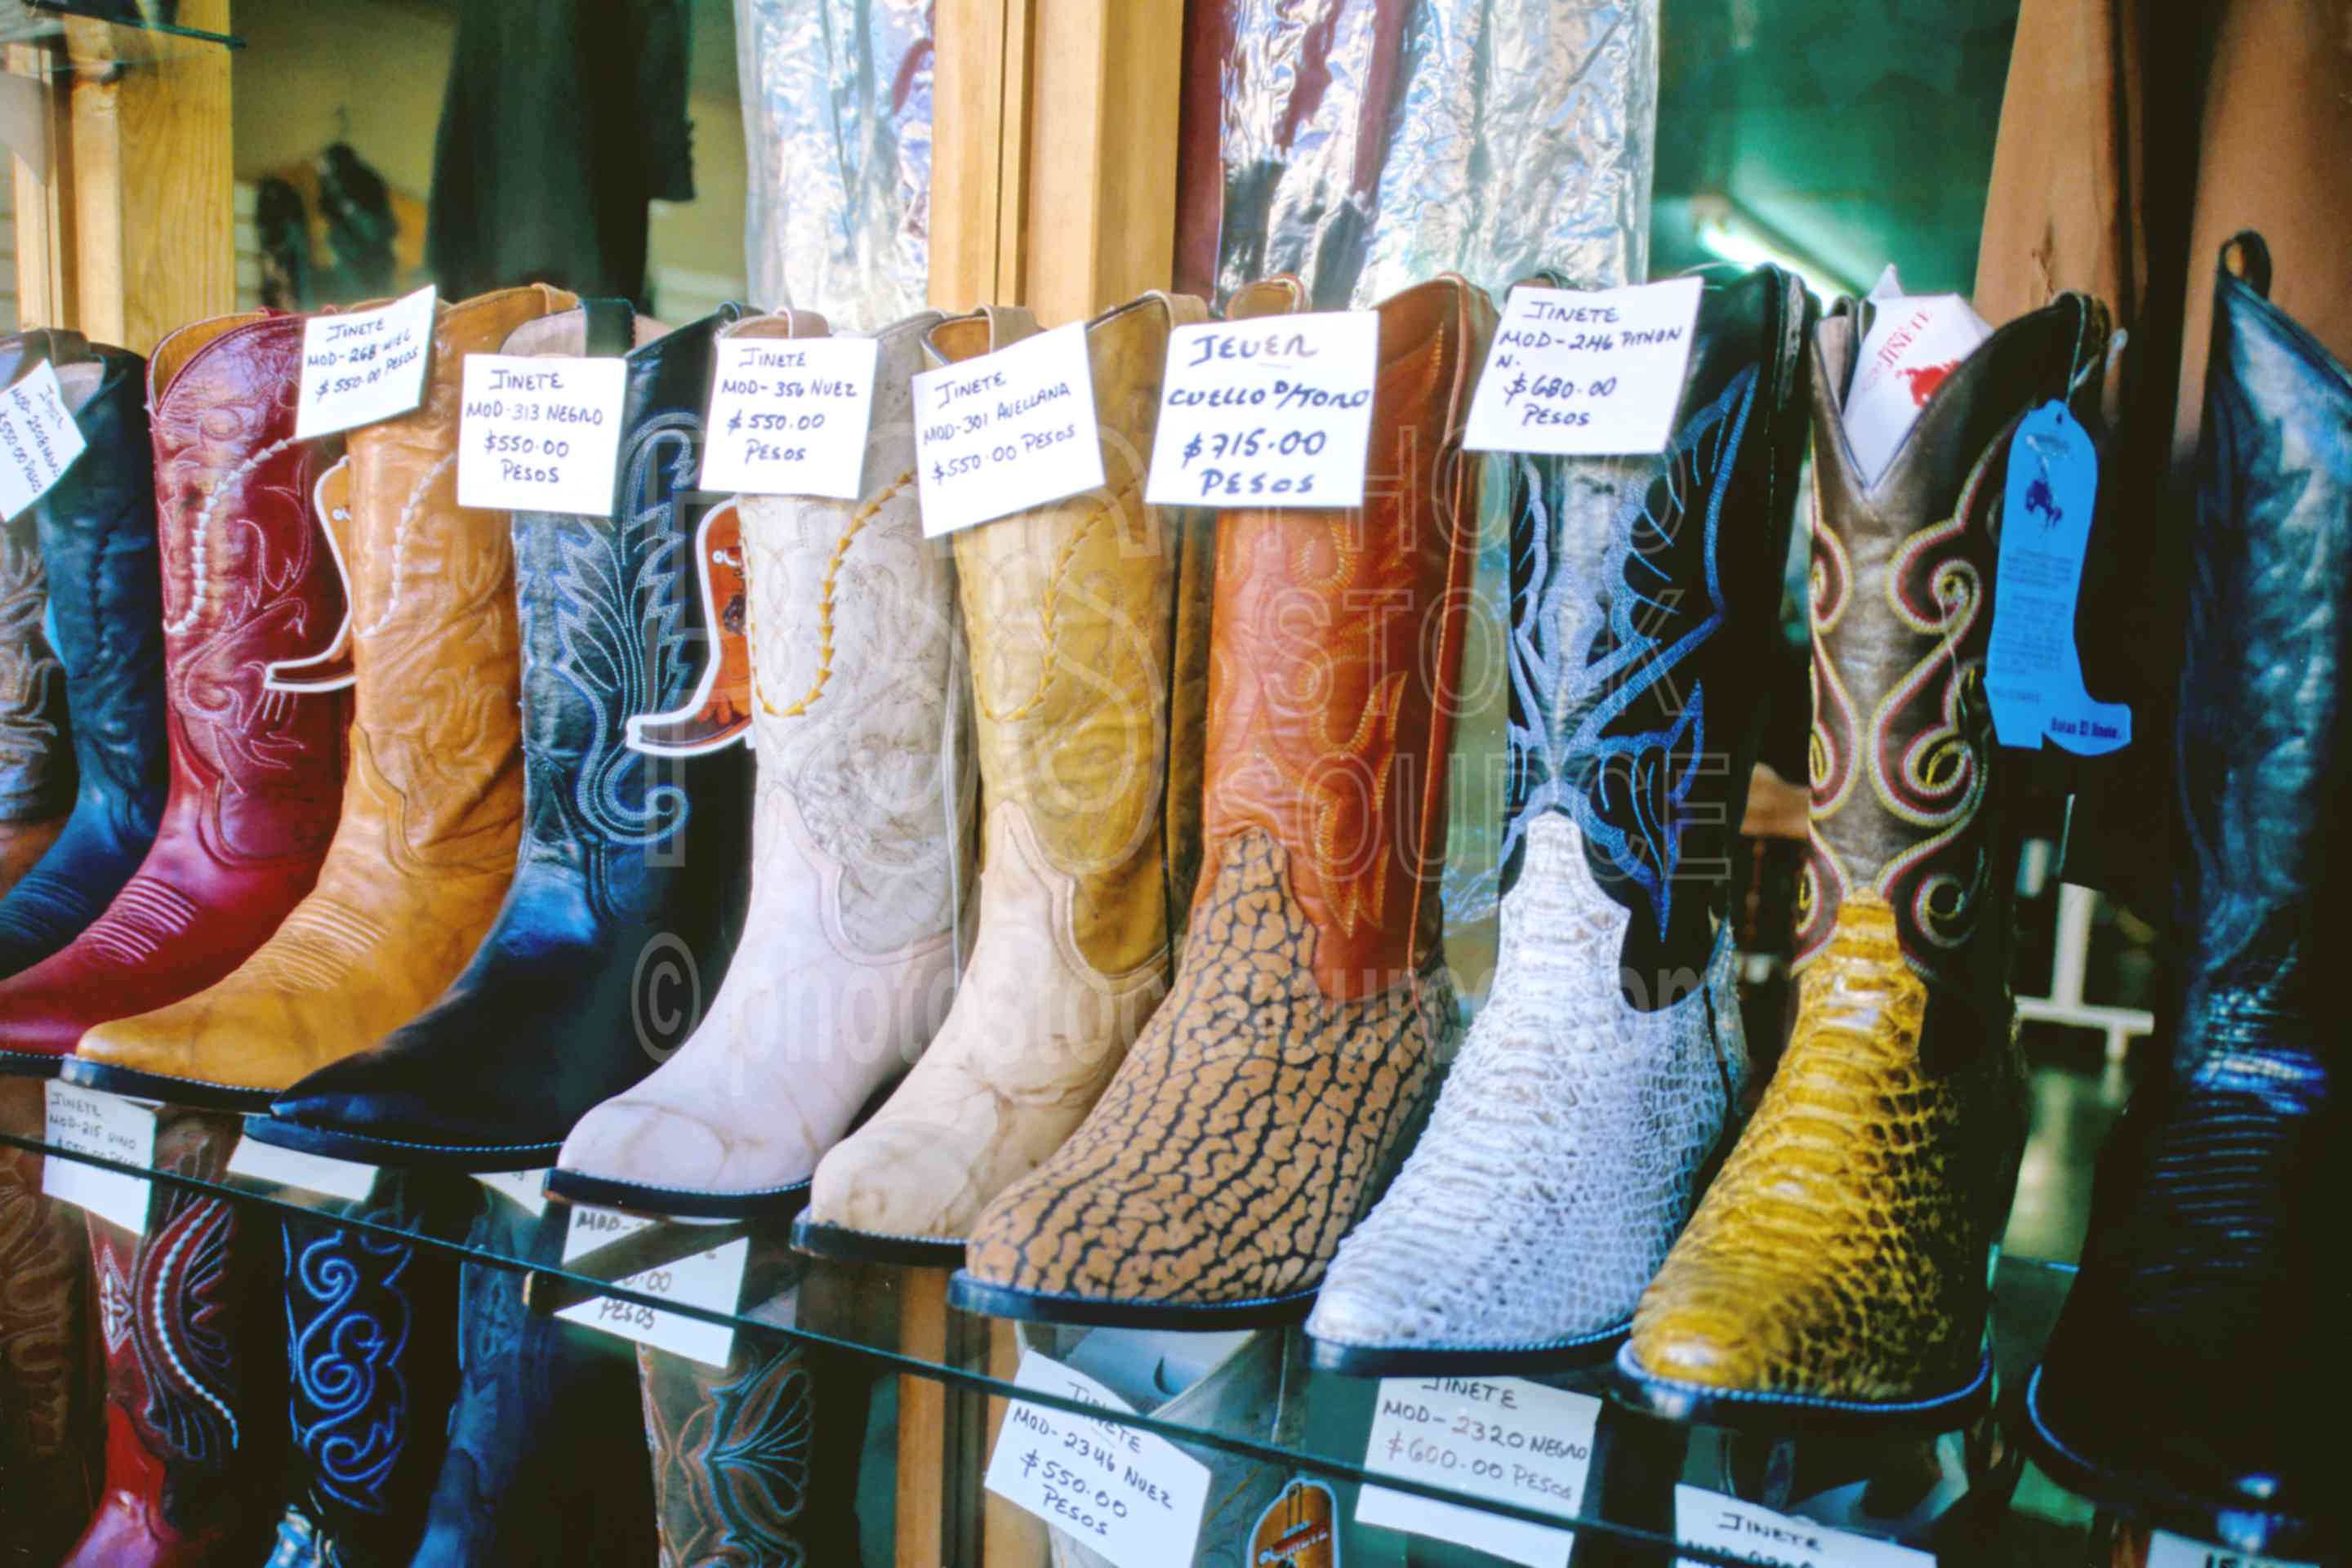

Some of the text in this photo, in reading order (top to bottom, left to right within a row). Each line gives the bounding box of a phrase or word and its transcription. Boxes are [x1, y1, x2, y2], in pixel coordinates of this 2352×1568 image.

[1522, 301, 1620, 323] JINETE
[326, 317, 385, 342] JINETE
[385, 346, 418, 375] PESOS
[738, 348, 806, 368] JINETE
[488, 370, 564, 390] JINETE
[811, 380, 858, 398] NUEZ
[934, 372, 1006, 408] JINETE
[1167, 388, 1266, 407] CUELLO
[728, 413, 825, 435] $550.00
[1522, 403, 1590, 426] PESOS
[483, 435, 569, 457] $550.00
[745, 439, 806, 463] PESOS
[931, 425, 1075, 480] $550.00 PESOS
[1183, 430, 1326, 467] $715.00
[500, 460, 559, 483] PESOS
[1199, 468, 1313, 496] PESOS
[51, 1091, 101, 1116] JINETE
[1420, 1377, 1518, 1410] JINETE
[1388, 1431, 1573, 1500] $600.00 PESOS
[1019, 1449, 1128, 1519] $550.00
[1124, 1466, 1174, 1510] NUEZ
[1042, 1483, 1109, 1536] PESOS
[1717, 1511, 1823, 1553] JINETE
